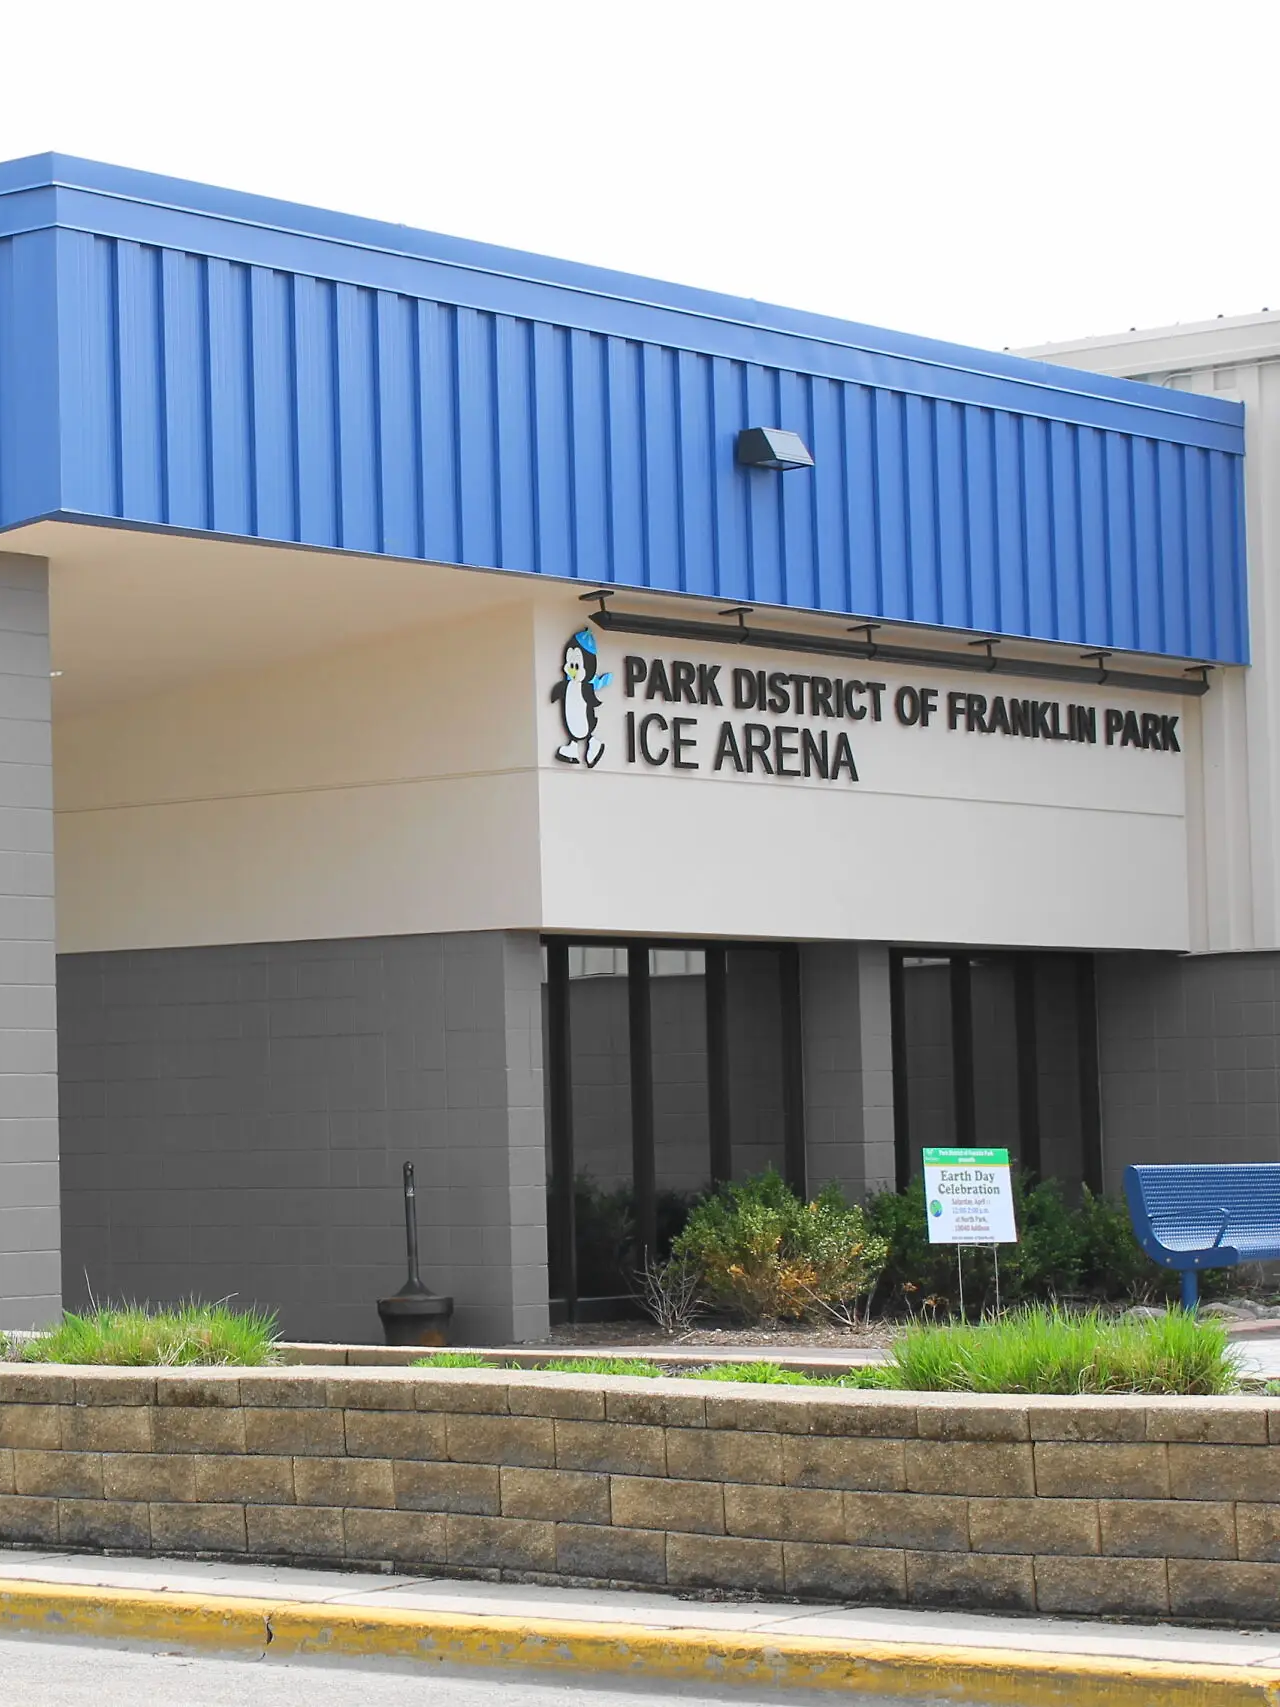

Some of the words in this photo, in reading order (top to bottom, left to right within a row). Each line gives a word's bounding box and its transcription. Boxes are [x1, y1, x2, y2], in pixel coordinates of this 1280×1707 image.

[625, 655, 724, 707] PARK
[732, 667, 887, 722] DISTRICT
[894, 685, 939, 728] OF
[947, 691, 1097, 744] FRANKLIN
[1104, 708, 1182, 753] PARK
[625, 711, 699, 770] ICE
[714, 721, 861, 782] ARENA
[937, 1183, 1000, 1195] Celebration
[940, 1170, 972, 1181] Earth
[974, 1170, 995, 1183] Day
